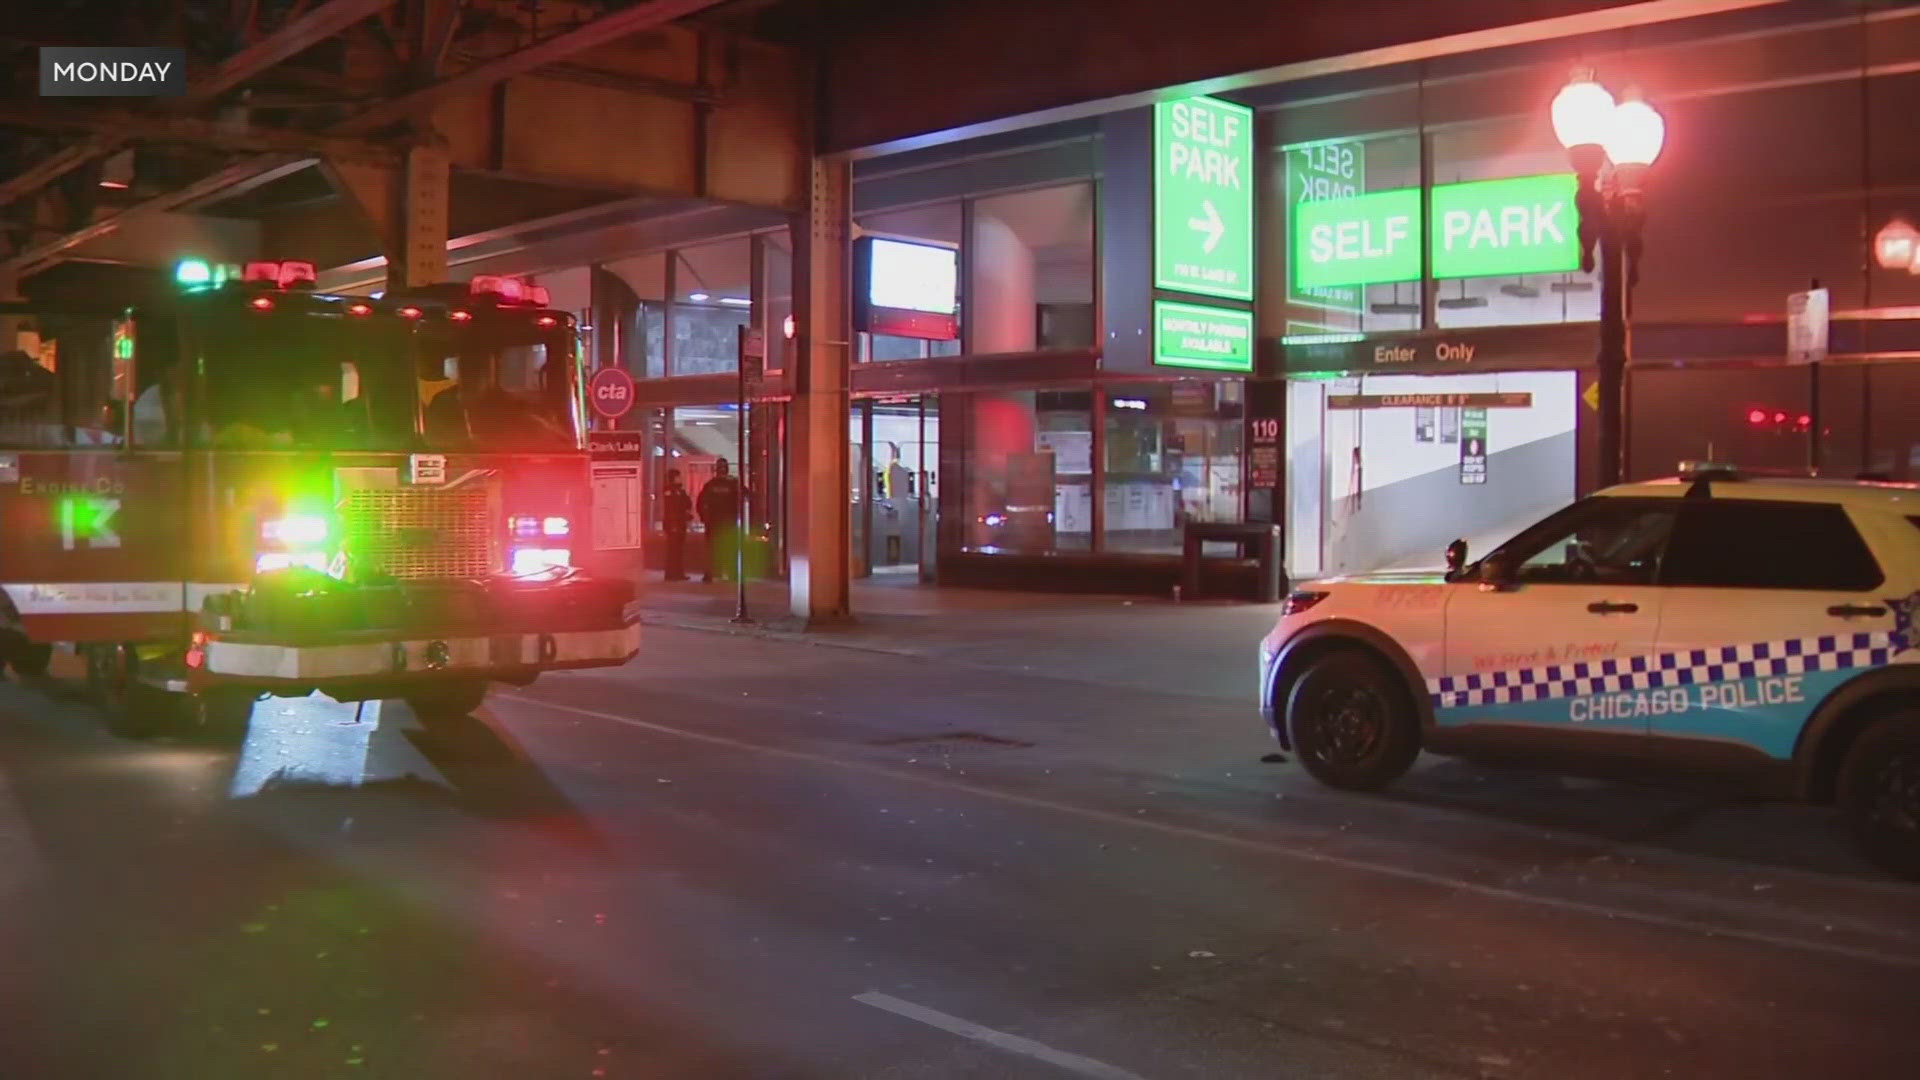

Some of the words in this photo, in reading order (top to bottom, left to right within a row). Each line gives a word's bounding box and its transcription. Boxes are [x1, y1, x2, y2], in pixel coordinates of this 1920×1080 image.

[1171, 102, 1239, 148] SELF
[1169, 142, 1241, 190] PARK
[1310, 215, 1409, 263] SELF
[1443, 201, 1565, 251] PARK
[1374, 345, 1416, 363] Enter
[1435, 342, 1475, 363] Only
[598, 384, 627, 400] cta
[1381, 395, 1442, 405] CLEARANCE
[1252, 420, 1278, 437] 110
[1569, 688, 1689, 722] CHICAGO
[1701, 676, 1805, 711] POLICE
